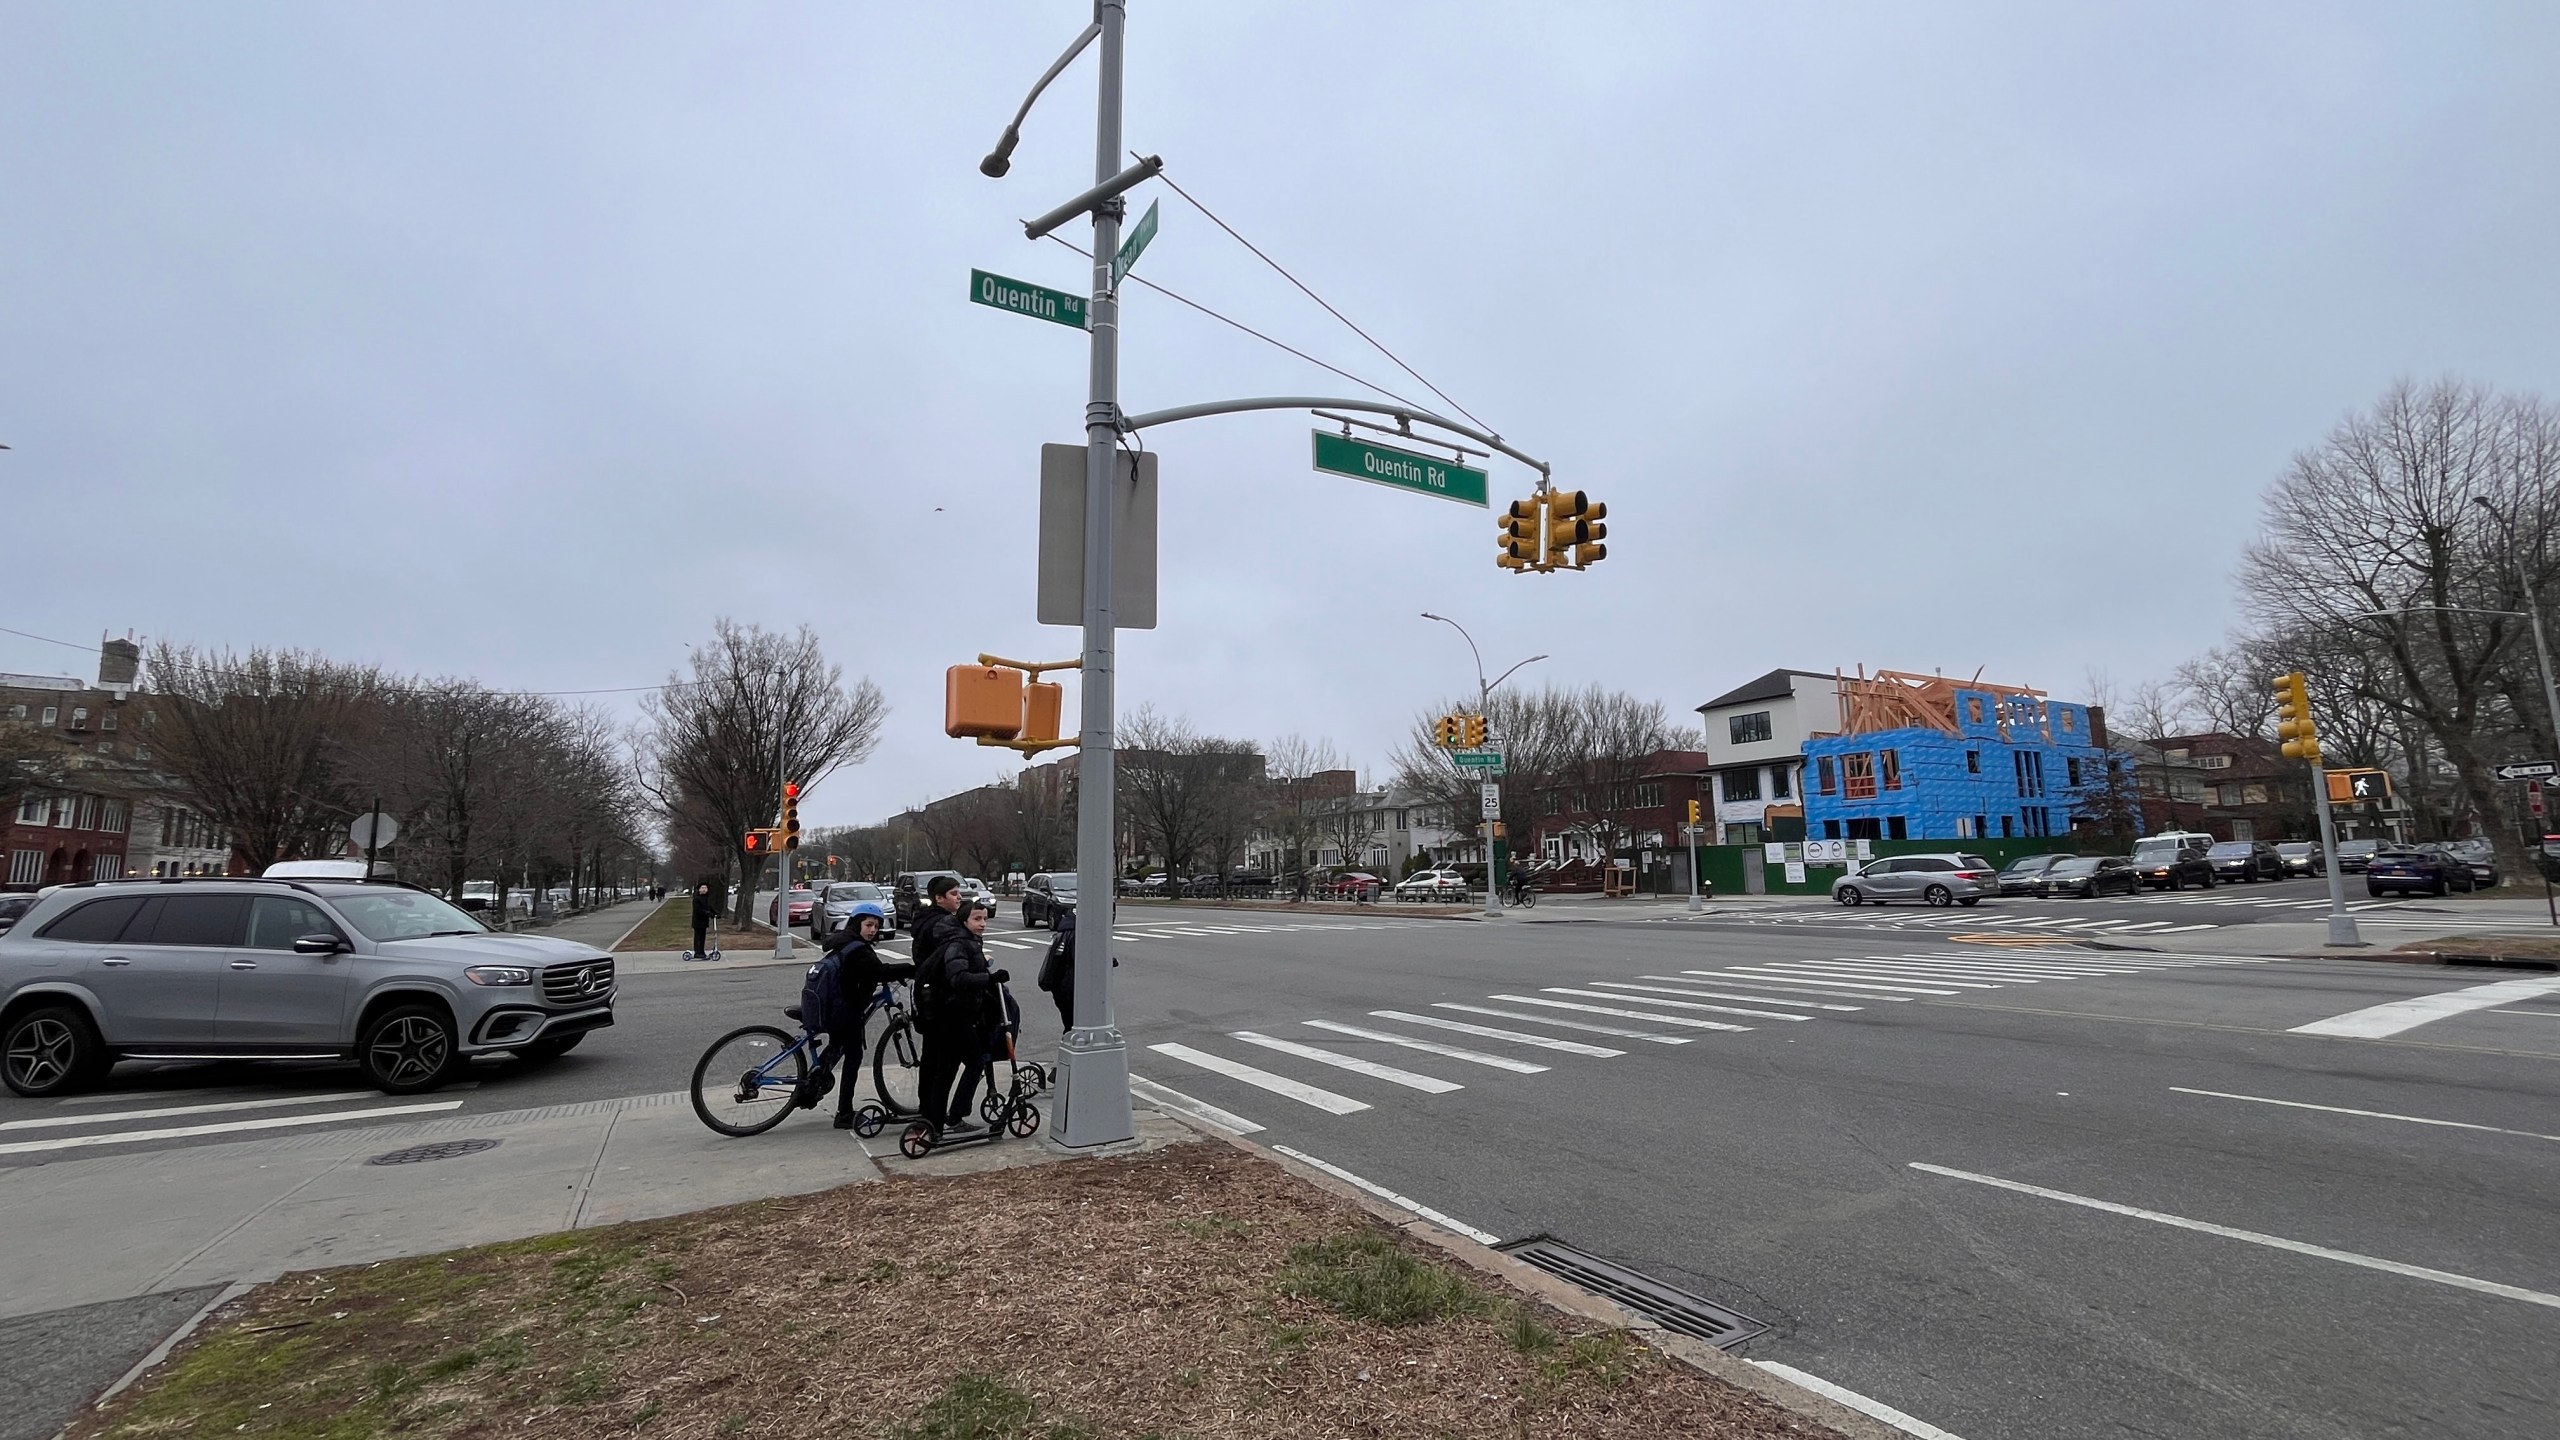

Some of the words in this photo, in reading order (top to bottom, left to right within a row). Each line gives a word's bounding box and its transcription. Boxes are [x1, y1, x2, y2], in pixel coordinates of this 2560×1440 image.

[1115, 238, 1137, 281] Ocean
[982, 276, 1056, 318] Quentin
[1064, 296, 1079, 313] Rd
[1364, 451, 1422, 483] Quentin
[1427, 466, 1446, 488] Rd
[1484, 797, 1498, 808] 25
